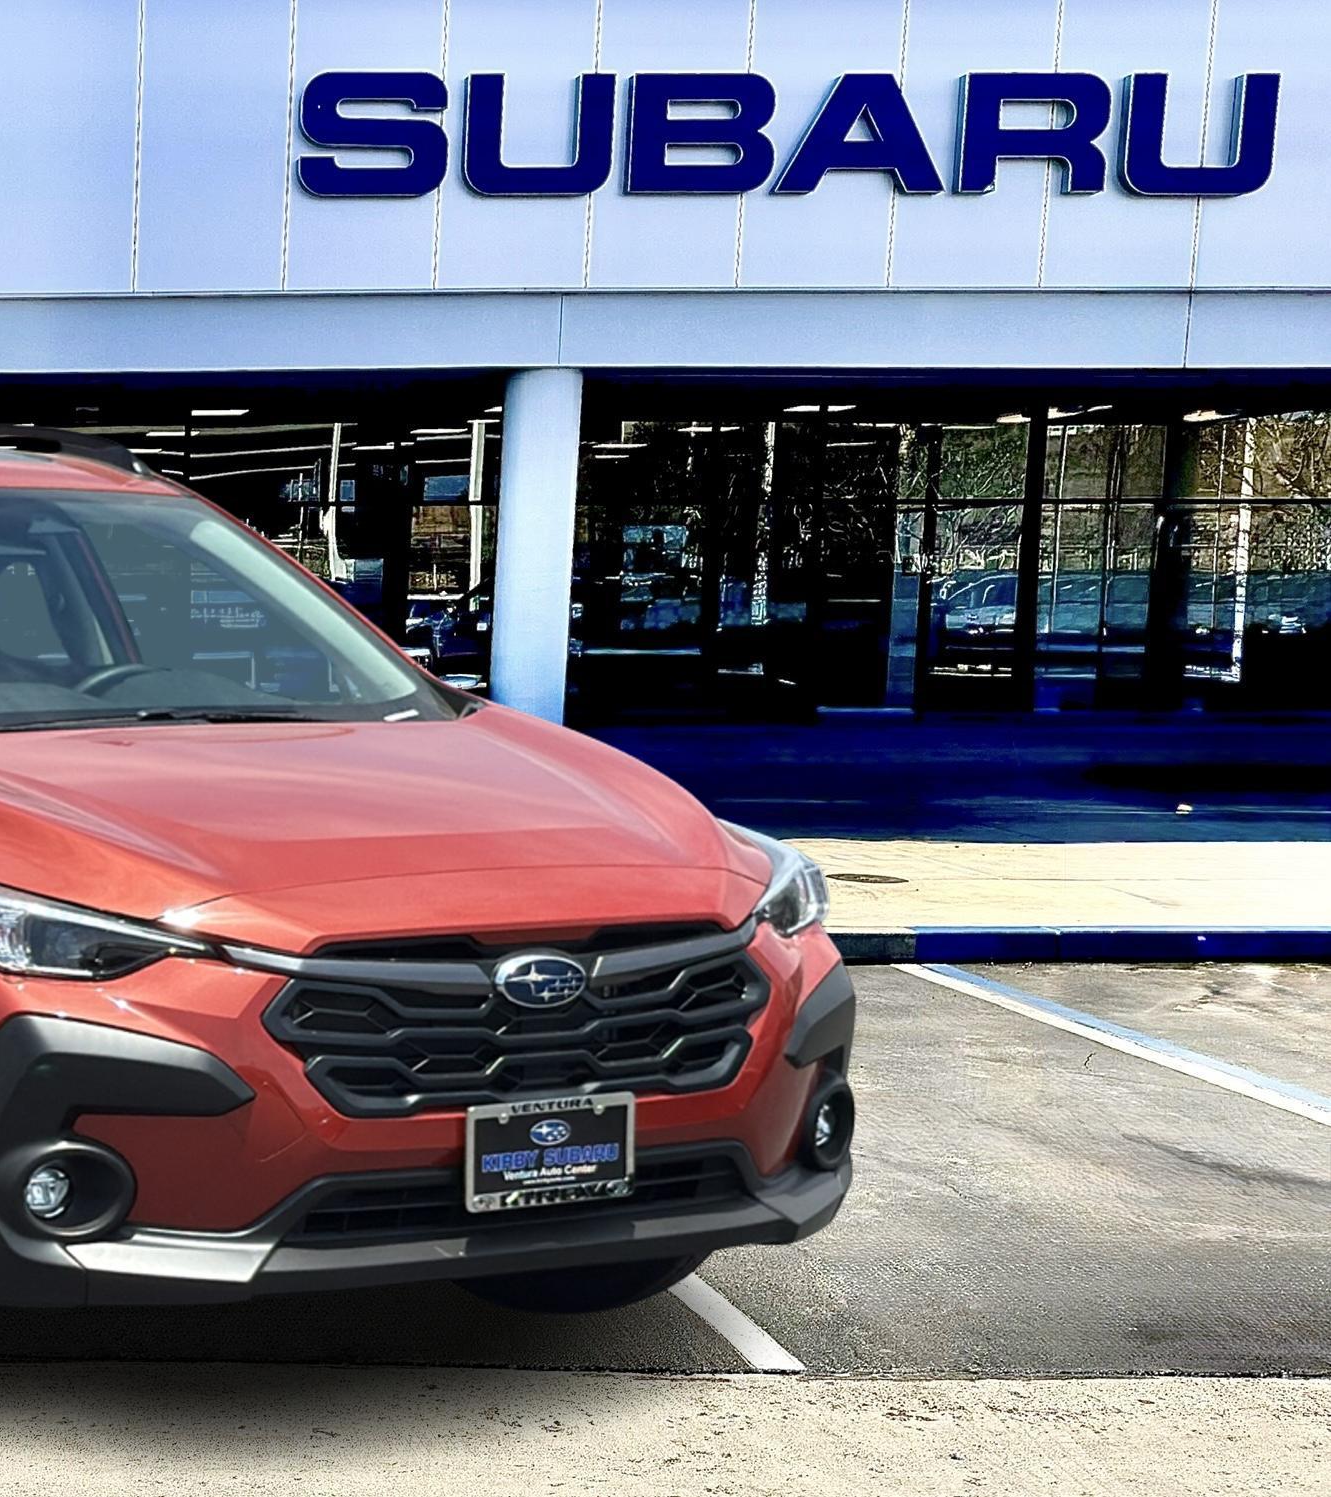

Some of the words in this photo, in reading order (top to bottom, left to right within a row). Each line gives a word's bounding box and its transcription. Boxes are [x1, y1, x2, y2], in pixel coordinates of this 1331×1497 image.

[297, 71, 1282, 197] SUBARU
[512, 1098, 594, 1113] VENTURA
[482, 1151, 538, 1172] KIRBY
[543, 1144, 618, 1165] SUBARU
[503, 1170, 538, 1181] Ventura
[539, 1166, 562, 1176] Auto
[564, 1164, 597, 1174] Center
